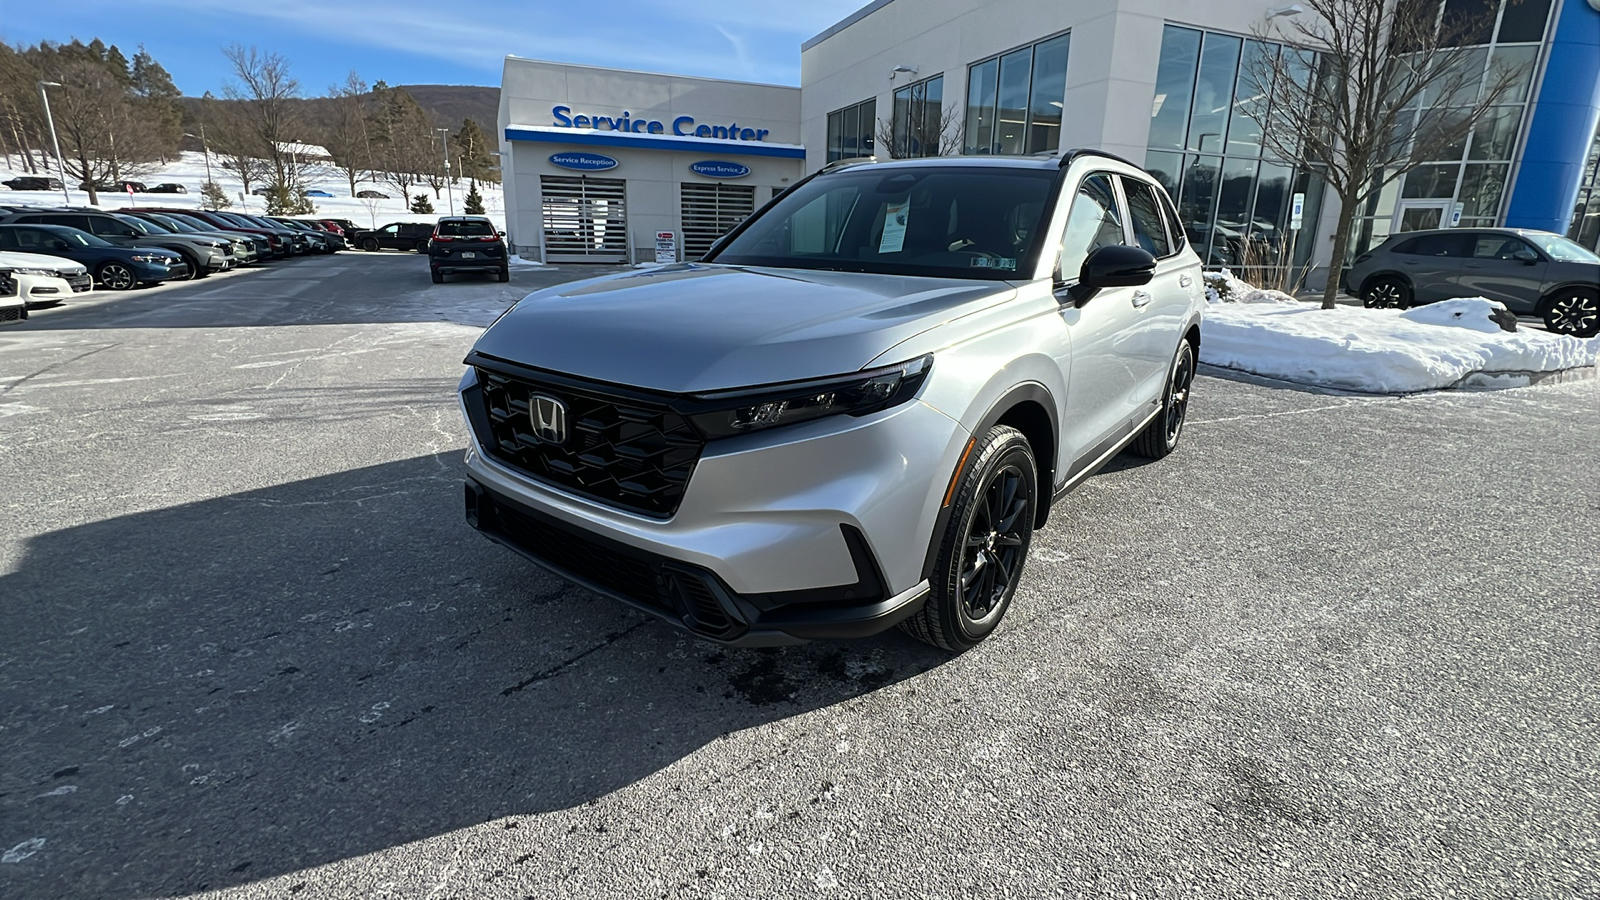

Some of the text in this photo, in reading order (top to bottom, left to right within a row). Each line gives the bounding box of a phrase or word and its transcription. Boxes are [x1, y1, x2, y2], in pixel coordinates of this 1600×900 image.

[552, 105, 770, 142] Service Center
[553, 155, 614, 166] Service Reception
[693, 164, 739, 173] Express Service
